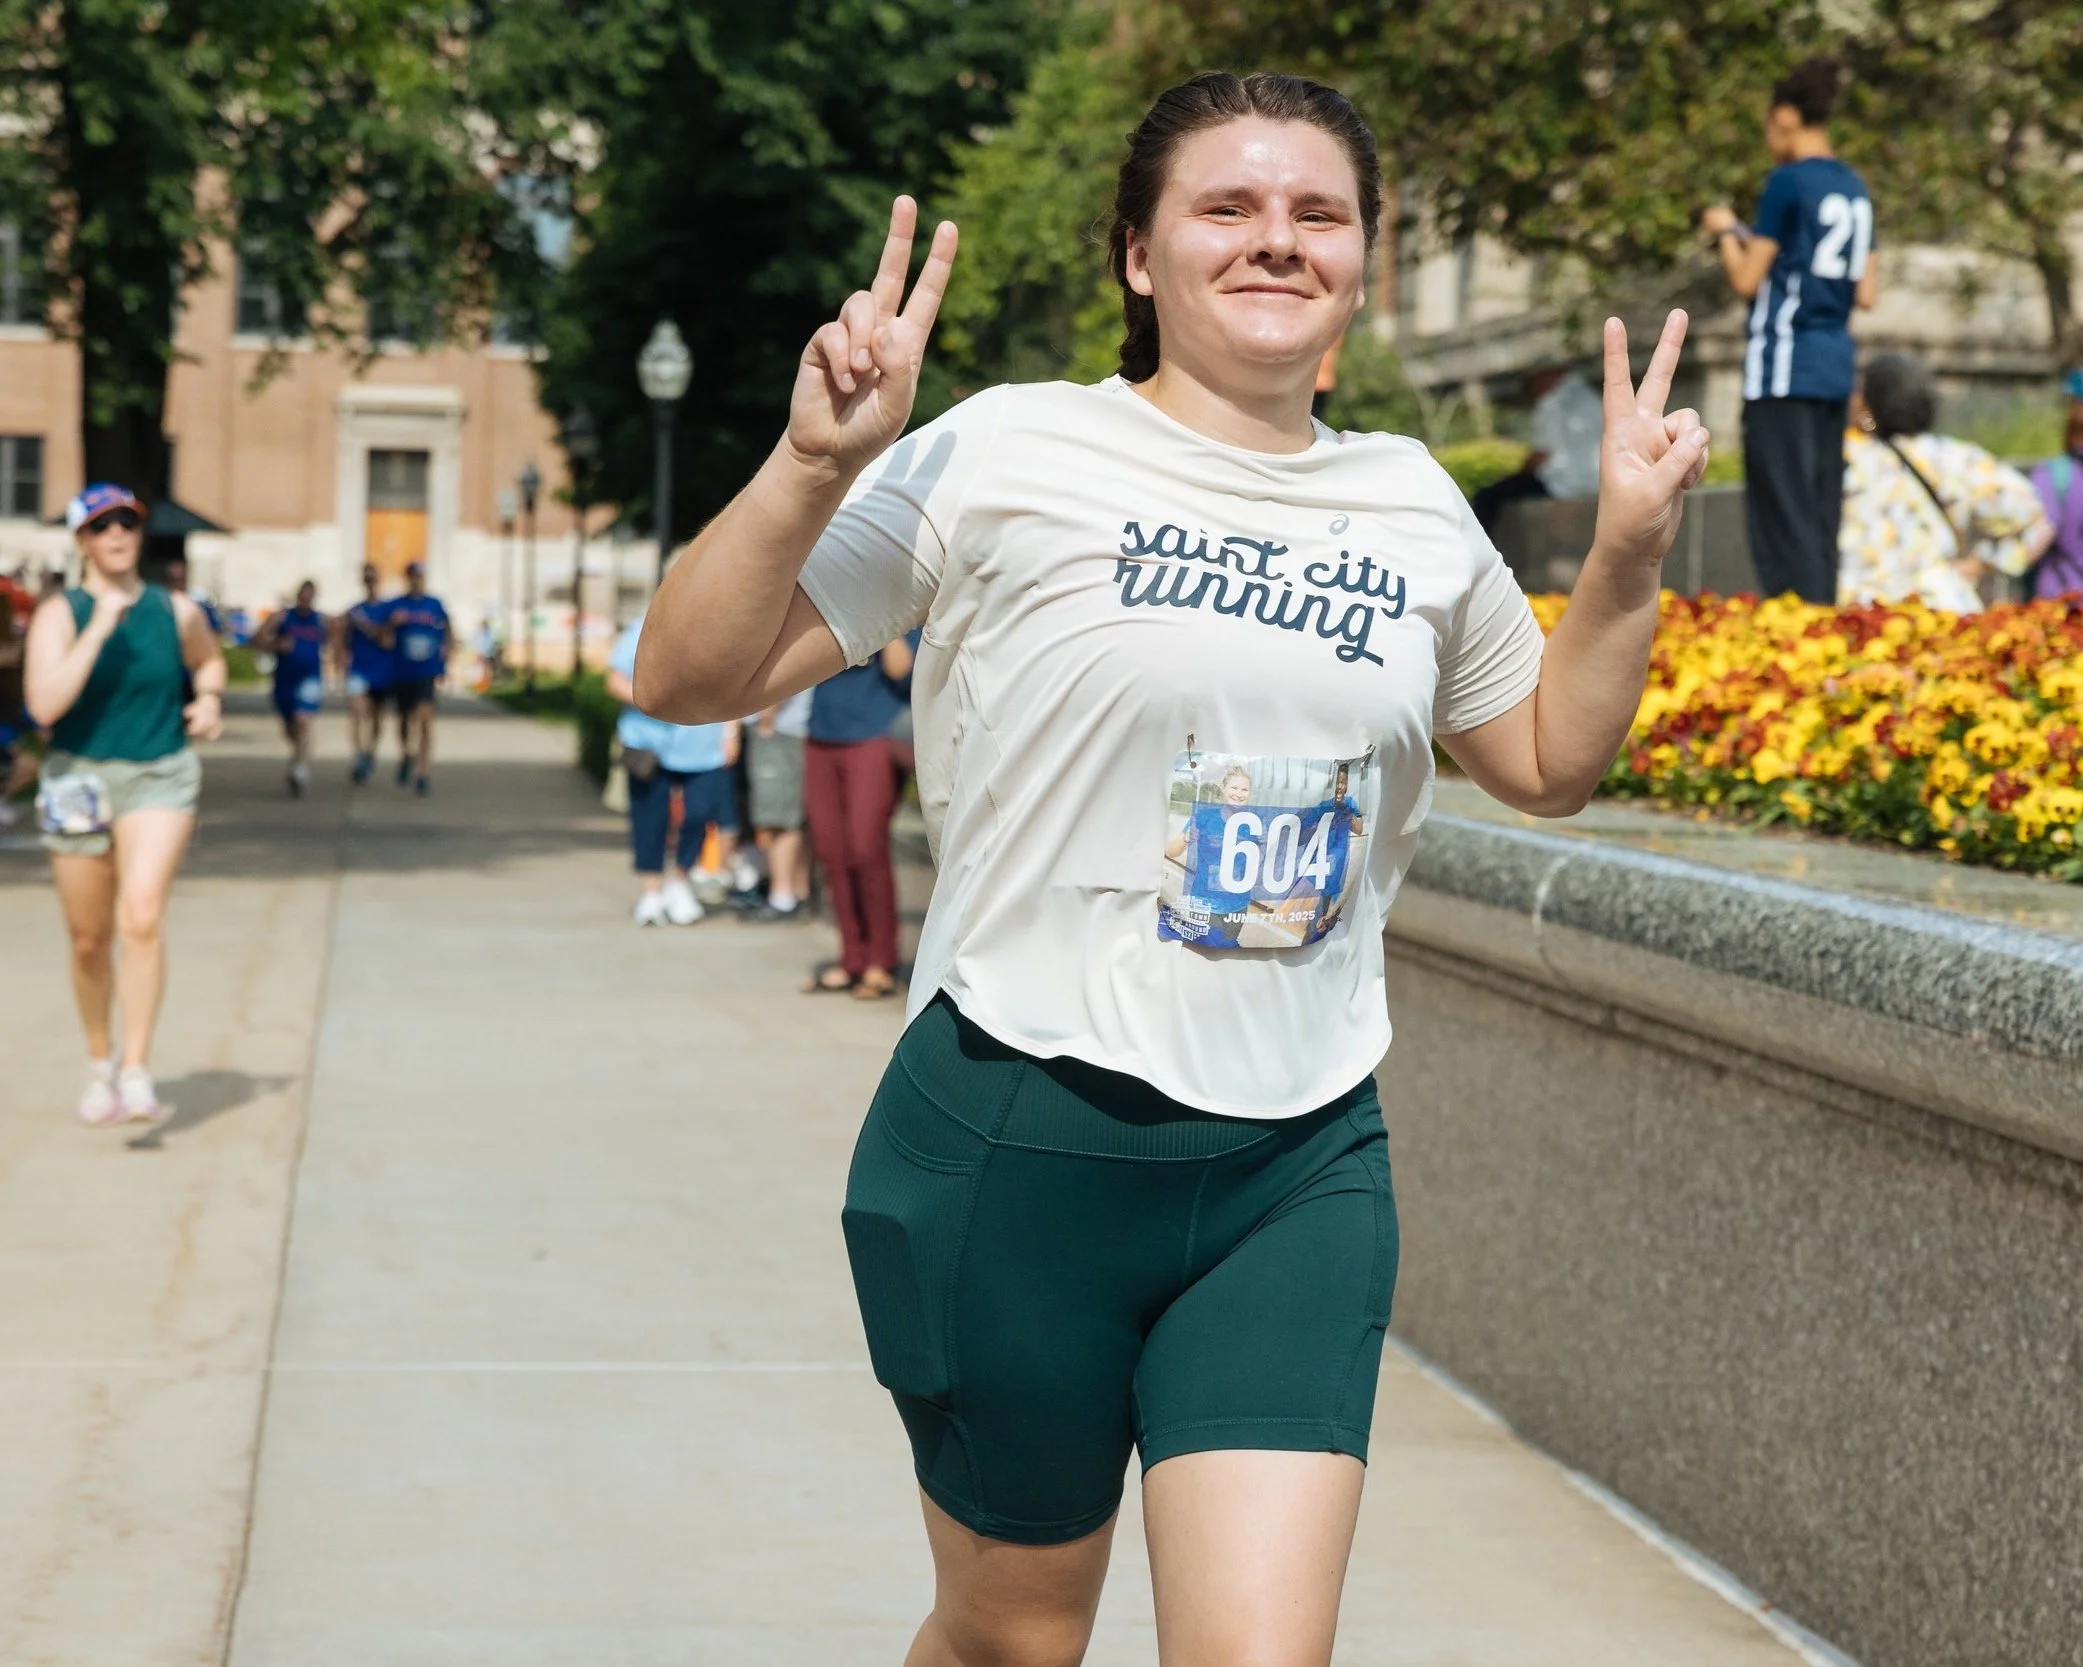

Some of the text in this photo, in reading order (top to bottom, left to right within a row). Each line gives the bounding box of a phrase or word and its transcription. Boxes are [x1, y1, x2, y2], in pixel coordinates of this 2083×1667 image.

[1811, 193, 1873, 281] 21
[1112, 558, 1384, 667] running
[1119, 521, 1406, 619] saint city
[1219, 811, 1335, 894] 604
[1288, 910, 1316, 922] 2025
